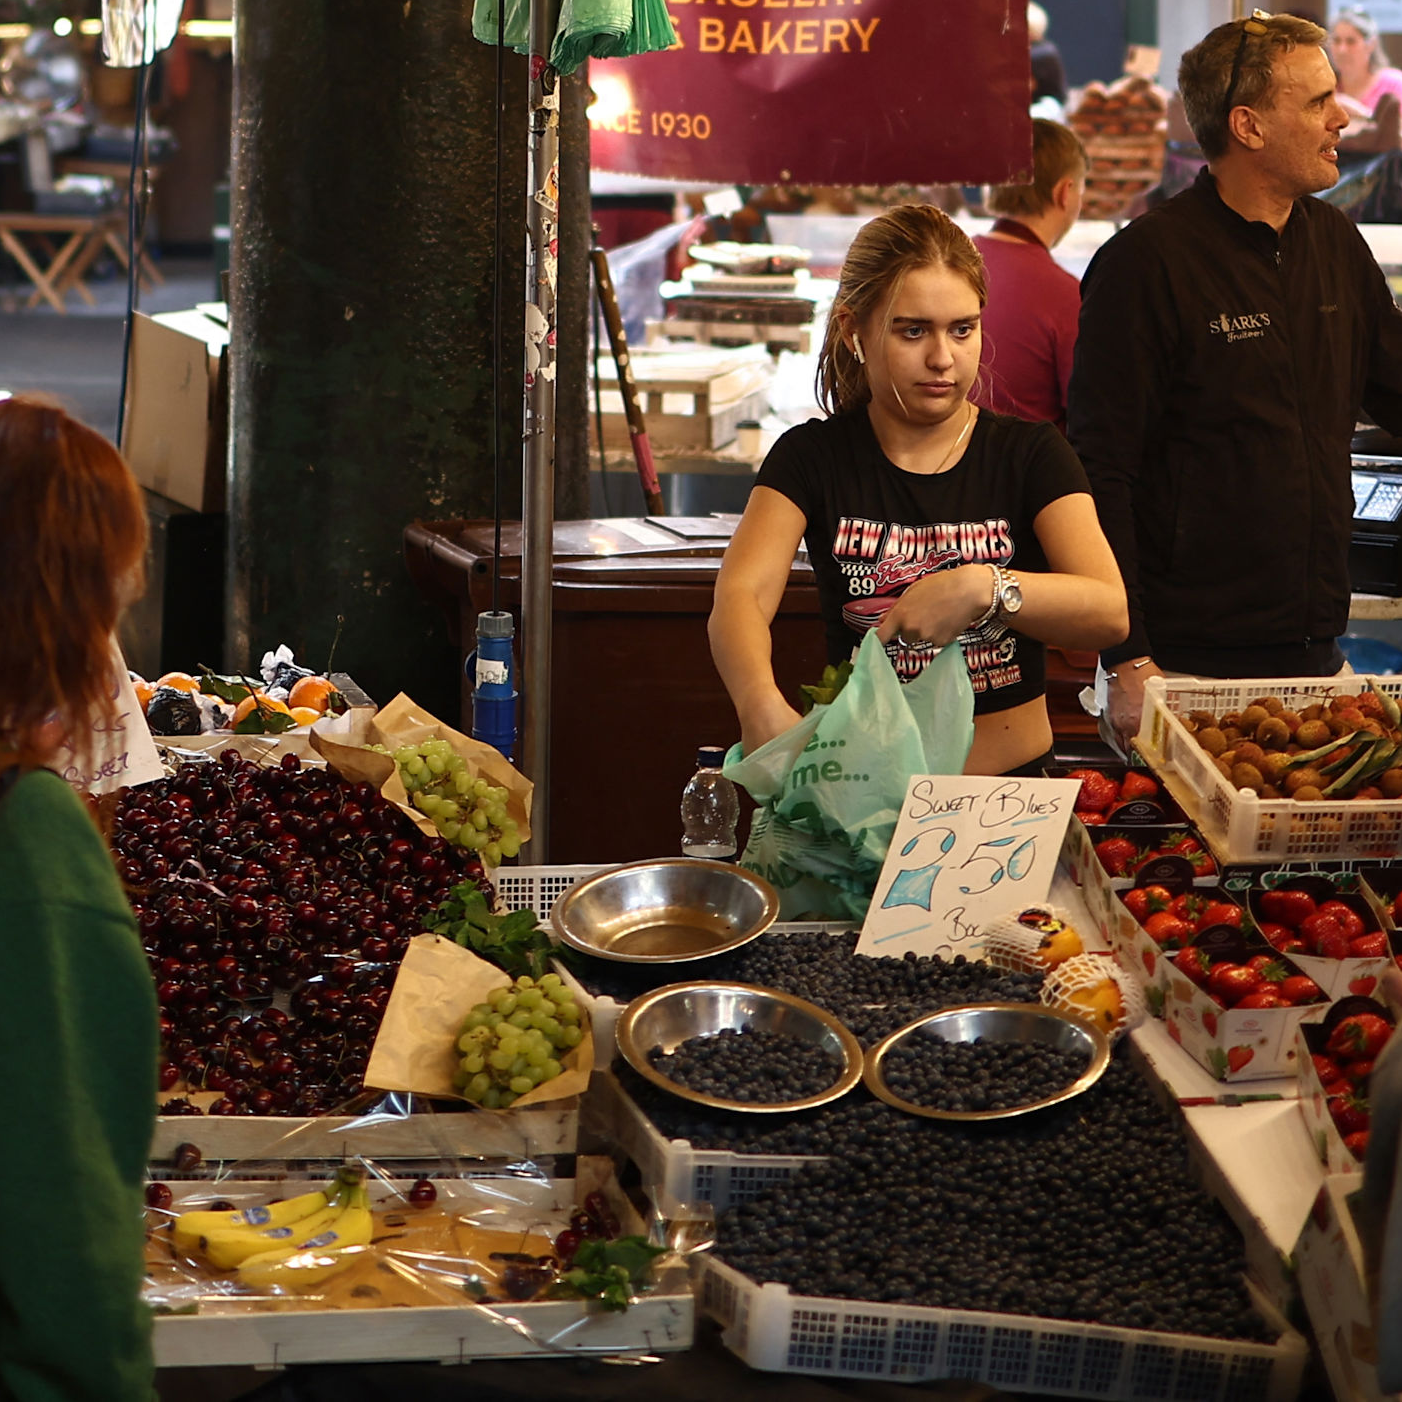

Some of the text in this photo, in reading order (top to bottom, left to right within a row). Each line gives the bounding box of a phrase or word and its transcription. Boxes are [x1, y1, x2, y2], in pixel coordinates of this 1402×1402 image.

[699, 17, 881, 55] BAKERY
[651, 111, 712, 140] 1930
[833, 518, 1014, 563] NEW ADVENTURES
[848, 577, 876, 596] 89
